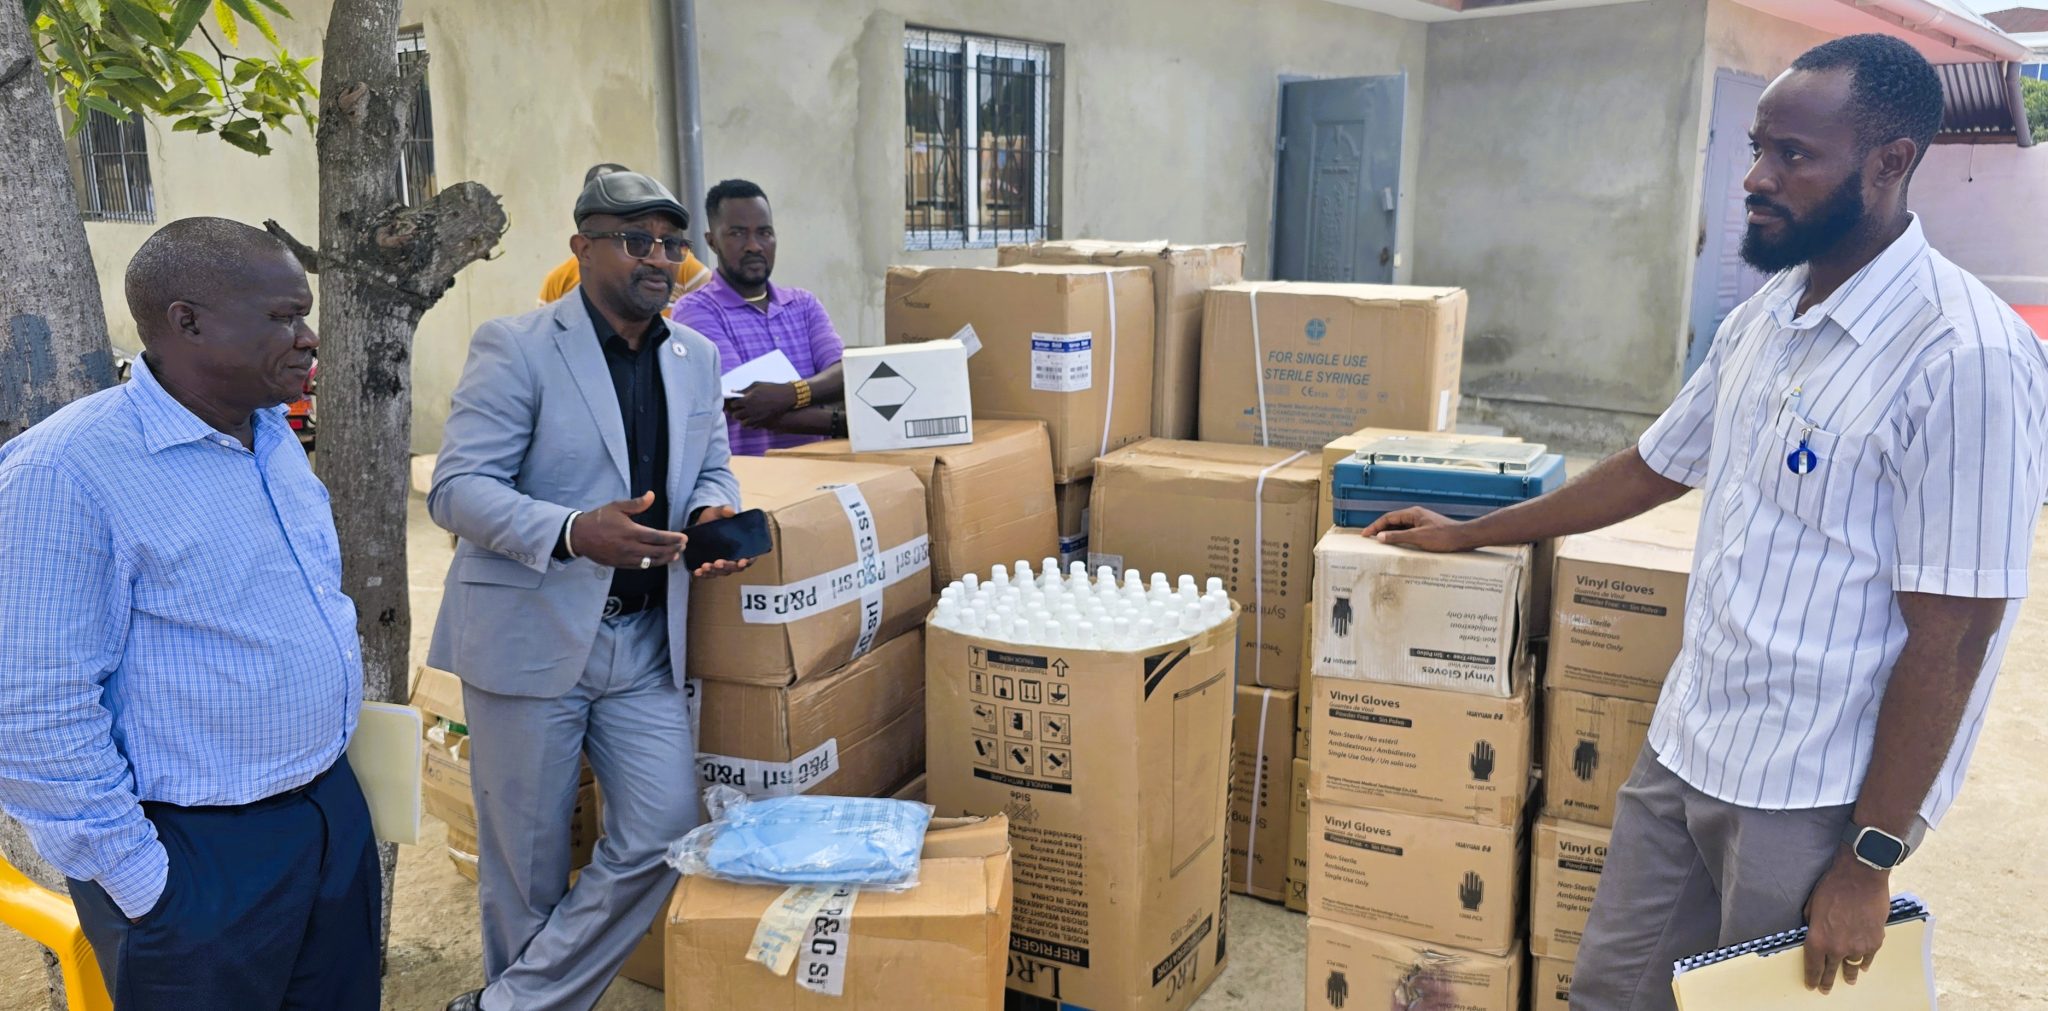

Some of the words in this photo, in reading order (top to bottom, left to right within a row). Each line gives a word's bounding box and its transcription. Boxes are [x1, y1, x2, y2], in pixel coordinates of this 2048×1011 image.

[1268, 351, 1293, 364] FOR
[1296, 352, 1340, 366] SINGLE
[1342, 355, 1368, 368] USE
[1264, 368, 1313, 382] STERILE
[1316, 371, 1371, 386] SYRINGE
[848, 502, 870, 530] srl
[896, 550, 911, 574] srl
[832, 573, 853, 599] srl
[1576, 575, 1608, 590] Vinyl
[1611, 580, 1654, 596] Gloves
[774, 586, 818, 615] P&C
[866, 600, 878, 631] srl
[1242, 602, 1286, 619] Syrige
[1446, 610, 1463, 618] Only
[1464, 612, 1476, 620] Use
[1478, 613, 1498, 622] Single
[1458, 634, 1496, 644] Non-Sterile
[1572, 626, 1620, 640] Ambidextrous
[1570, 637, 1591, 647] Single
[1592, 640, 1605, 648] Use
[1606, 644, 1623, 652] Only
[1421, 666, 1462, 678] Gloves
[1464, 670, 1494, 682] Vinyl
[1330, 690, 1358, 704] Vinyl
[1361, 695, 1400, 709] Gloves
[1329, 730, 1363, 740] Non-Sterile
[1328, 740, 1372, 752] Ambidextrous
[1328, 750, 1346, 759] Single
[1348, 752, 1359, 760] Use
[1360, 754, 1376, 763] Only
[798, 750, 829, 784] P&C
[704, 762, 746, 786] P&C
[763, 770, 793, 789] srl
[1008, 778, 1024, 786] WITH
[1026, 780, 1053, 790] HANDLE
[1010, 790, 1031, 802] Side
[1232, 810, 1268, 828] Sring
[1018, 826, 1042, 835] handle
[1325, 815, 1351, 830] Vinyl
[1354, 822, 1392, 836] Gloves
[1040, 838, 1062, 846] power
[1065, 842, 1082, 850] Less
[1560, 840, 1591, 856] Vinyl
[1030, 844, 1054, 854] saving
[1056, 848, 1082, 860] Energy
[1018, 852, 1038, 860] room
[1038, 858, 1064, 866] freezer
[1324, 852, 1357, 864] Non-Sterile
[1022, 870, 1034, 878] key
[1038, 864, 1065, 874] cooling
[1324, 872, 1342, 882] Single
[1342, 875, 1354, 884] Use
[1355, 878, 1368, 887] Only
[1044, 884, 1083, 896] Adjustable
[1558, 881, 1596, 892] Non-Sterile
[1031, 892, 1055, 904] CHINA
[1056, 897, 1064, 905] IN
[1066, 899, 1088, 909] MADE
[1556, 902, 1578, 912] Single
[1578, 904, 1590, 912] Use
[1061, 916, 1088, 926] GROSS
[812, 908, 843, 956] P&C
[1060, 925, 1088, 936] POWER
[1062, 934, 1088, 944] MODEL
[1011, 936, 1080, 962] REFRIGER
[1156, 918, 1210, 980] REFRIGERATOR
[1165, 948, 1199, 1002] LRC
